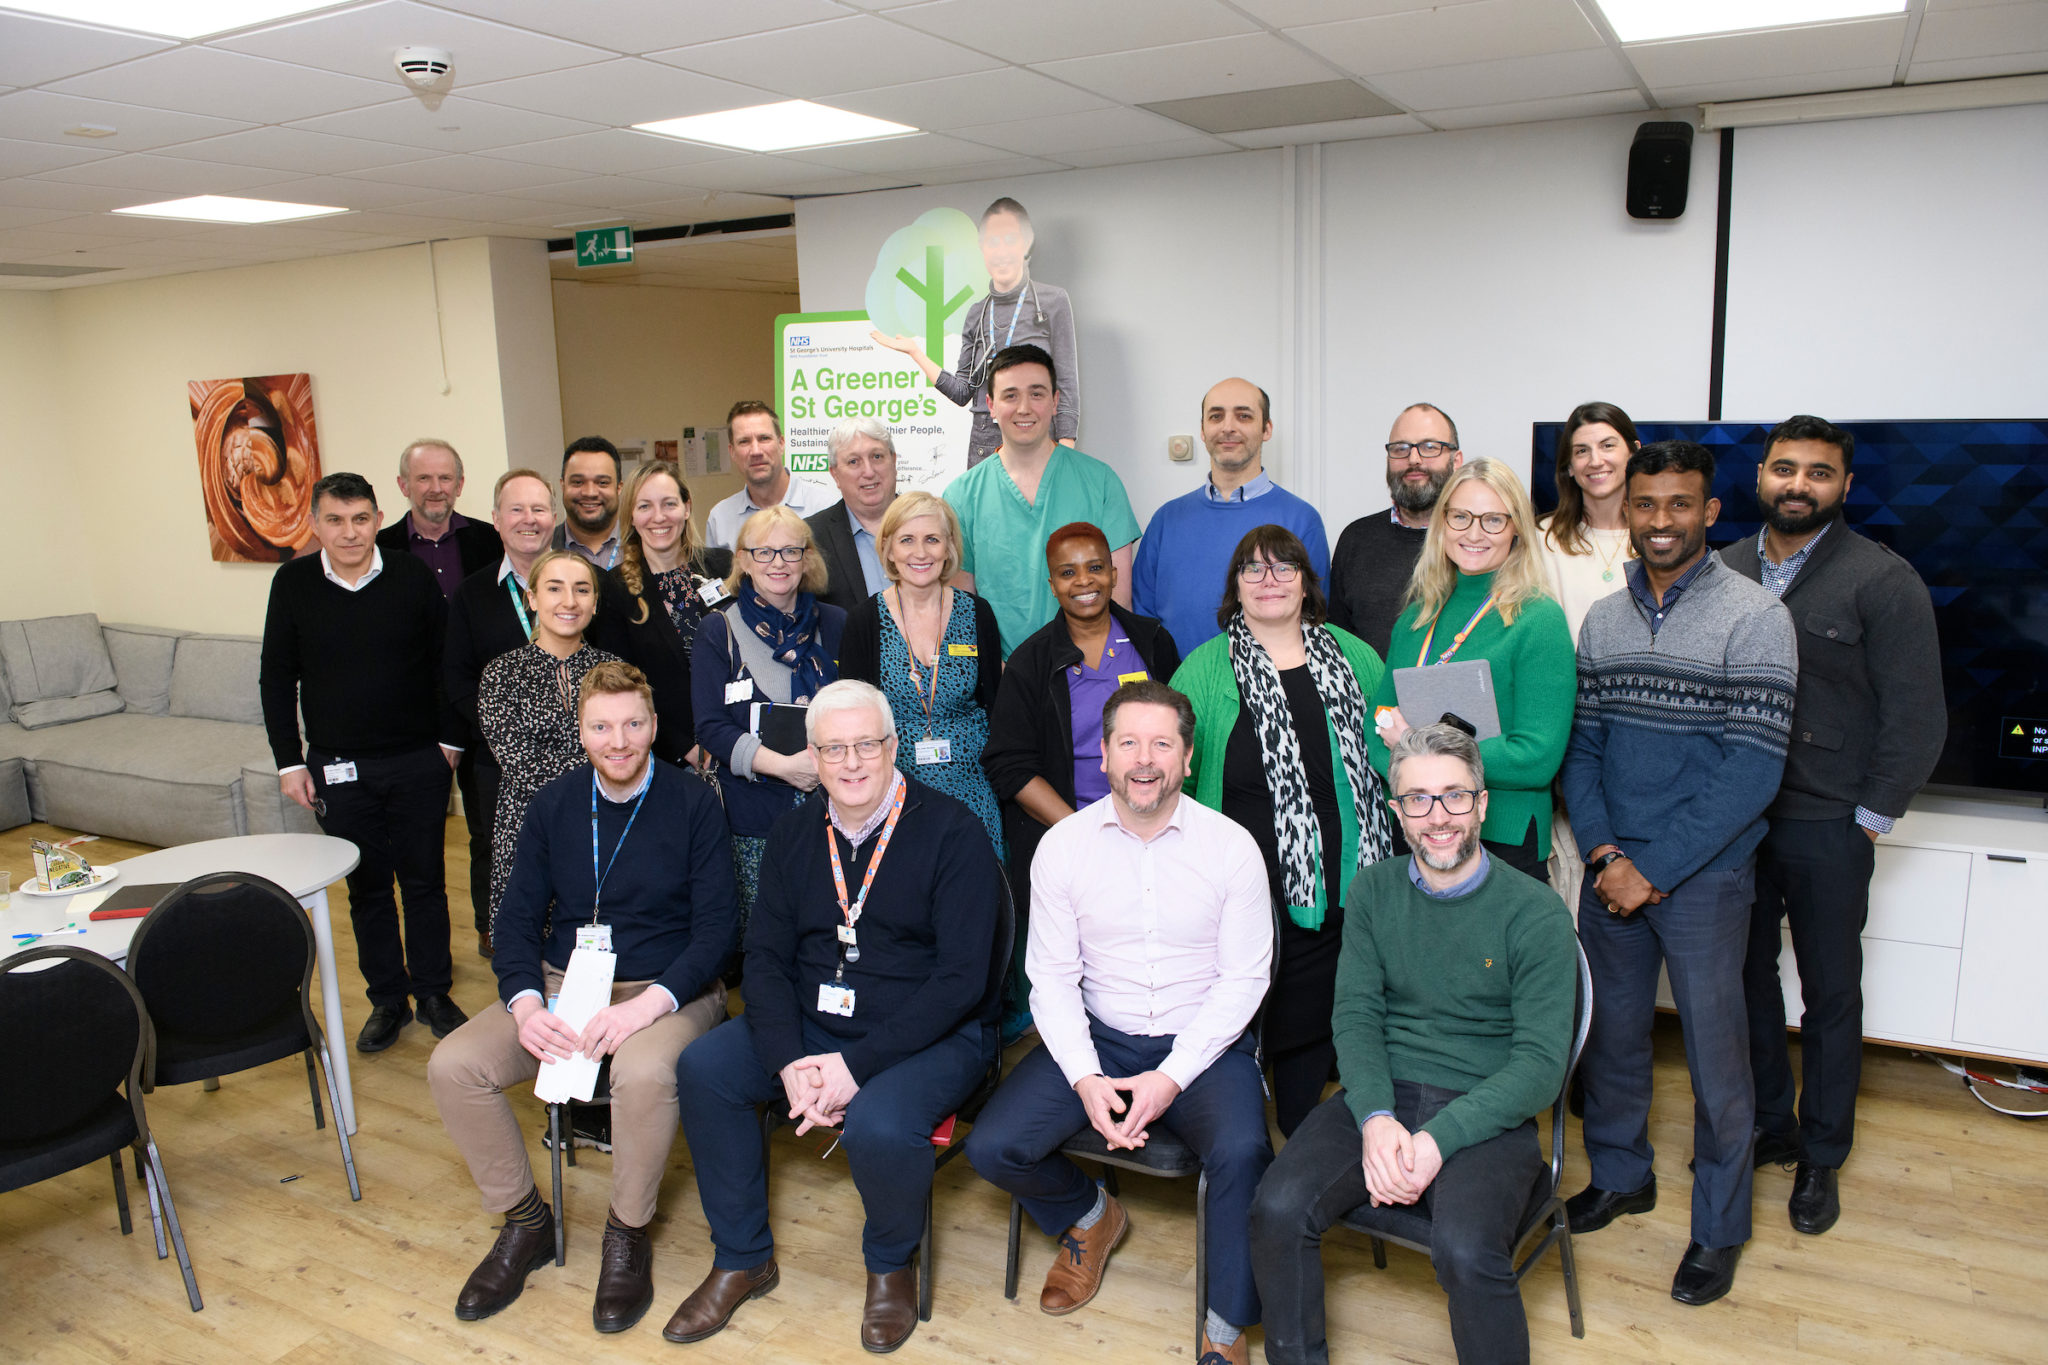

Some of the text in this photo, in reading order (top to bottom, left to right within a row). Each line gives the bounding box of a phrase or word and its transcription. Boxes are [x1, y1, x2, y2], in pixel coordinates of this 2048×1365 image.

[790, 336, 810, 346] NHS
[791, 367, 920, 391] A Greener
[791, 393, 937, 423] St George's
[790, 427, 830, 436] Healthier
[910, 425, 945, 436] People,
[790, 438, 829, 447] Sustaina
[792, 455, 829, 471] NHS
[2034, 727, 2047, 735] No
[2032, 745, 2048, 753] INP
